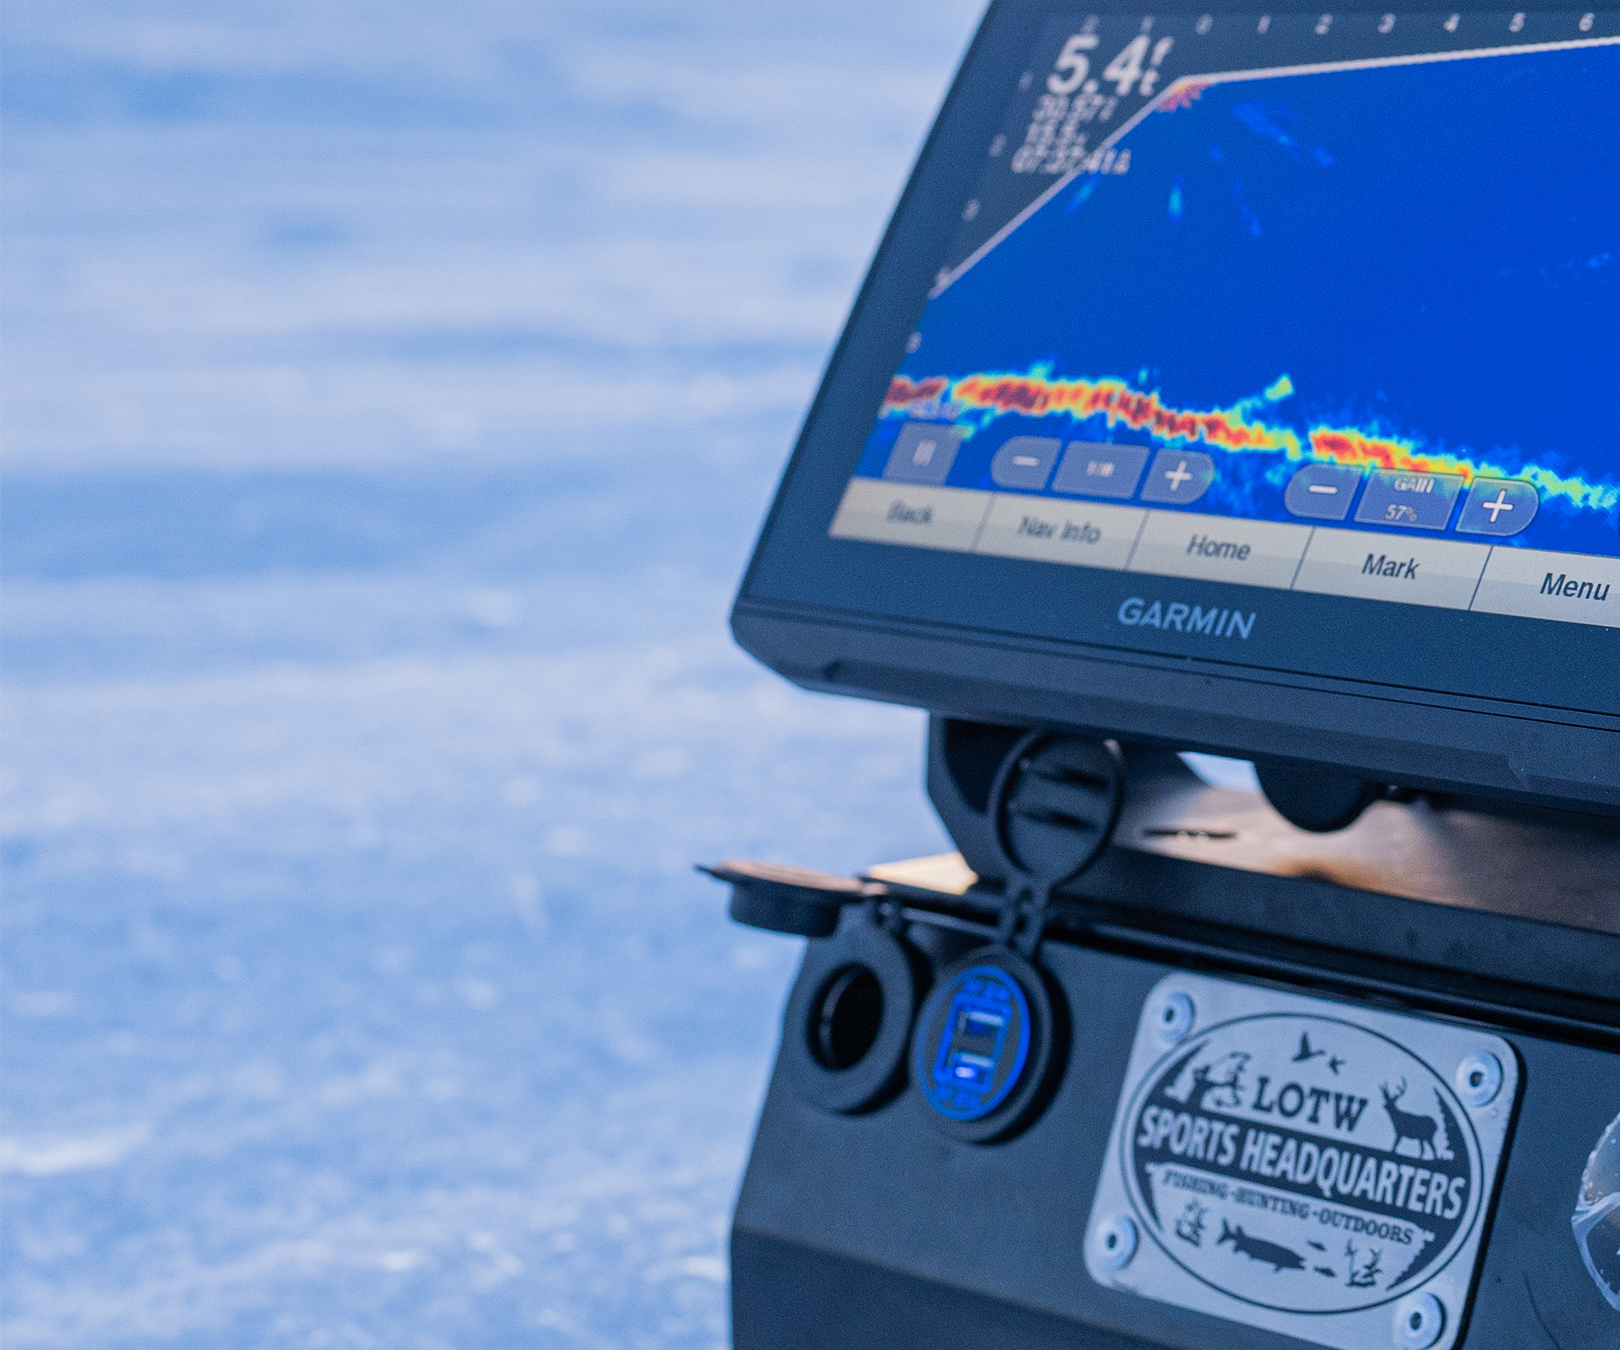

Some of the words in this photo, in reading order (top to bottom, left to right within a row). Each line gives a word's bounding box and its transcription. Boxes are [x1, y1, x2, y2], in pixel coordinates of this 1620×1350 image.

[1378, 13, 1397, 34] 3
[1443, 13, 1460, 32] 4
[1579, 12, 1595, 31] 6
[1394, 476, 1434, 494] GAIN
[886, 500, 933, 525] Back
[1385, 503, 1418, 523] 57%
[1017, 516, 1056, 539] Nav
[1061, 519, 1102, 544] Info
[1187, 535, 1251, 561] Home
[1362, 554, 1421, 580] Mark
[1540, 572, 1610, 601] Menu
[1118, 596, 1257, 640] GARMIN
[1252, 1076, 1369, 1134] LOTW
[1137, 1104, 1240, 1166] SPORTS
[1239, 1134, 1467, 1220] HEADQUARTERS
